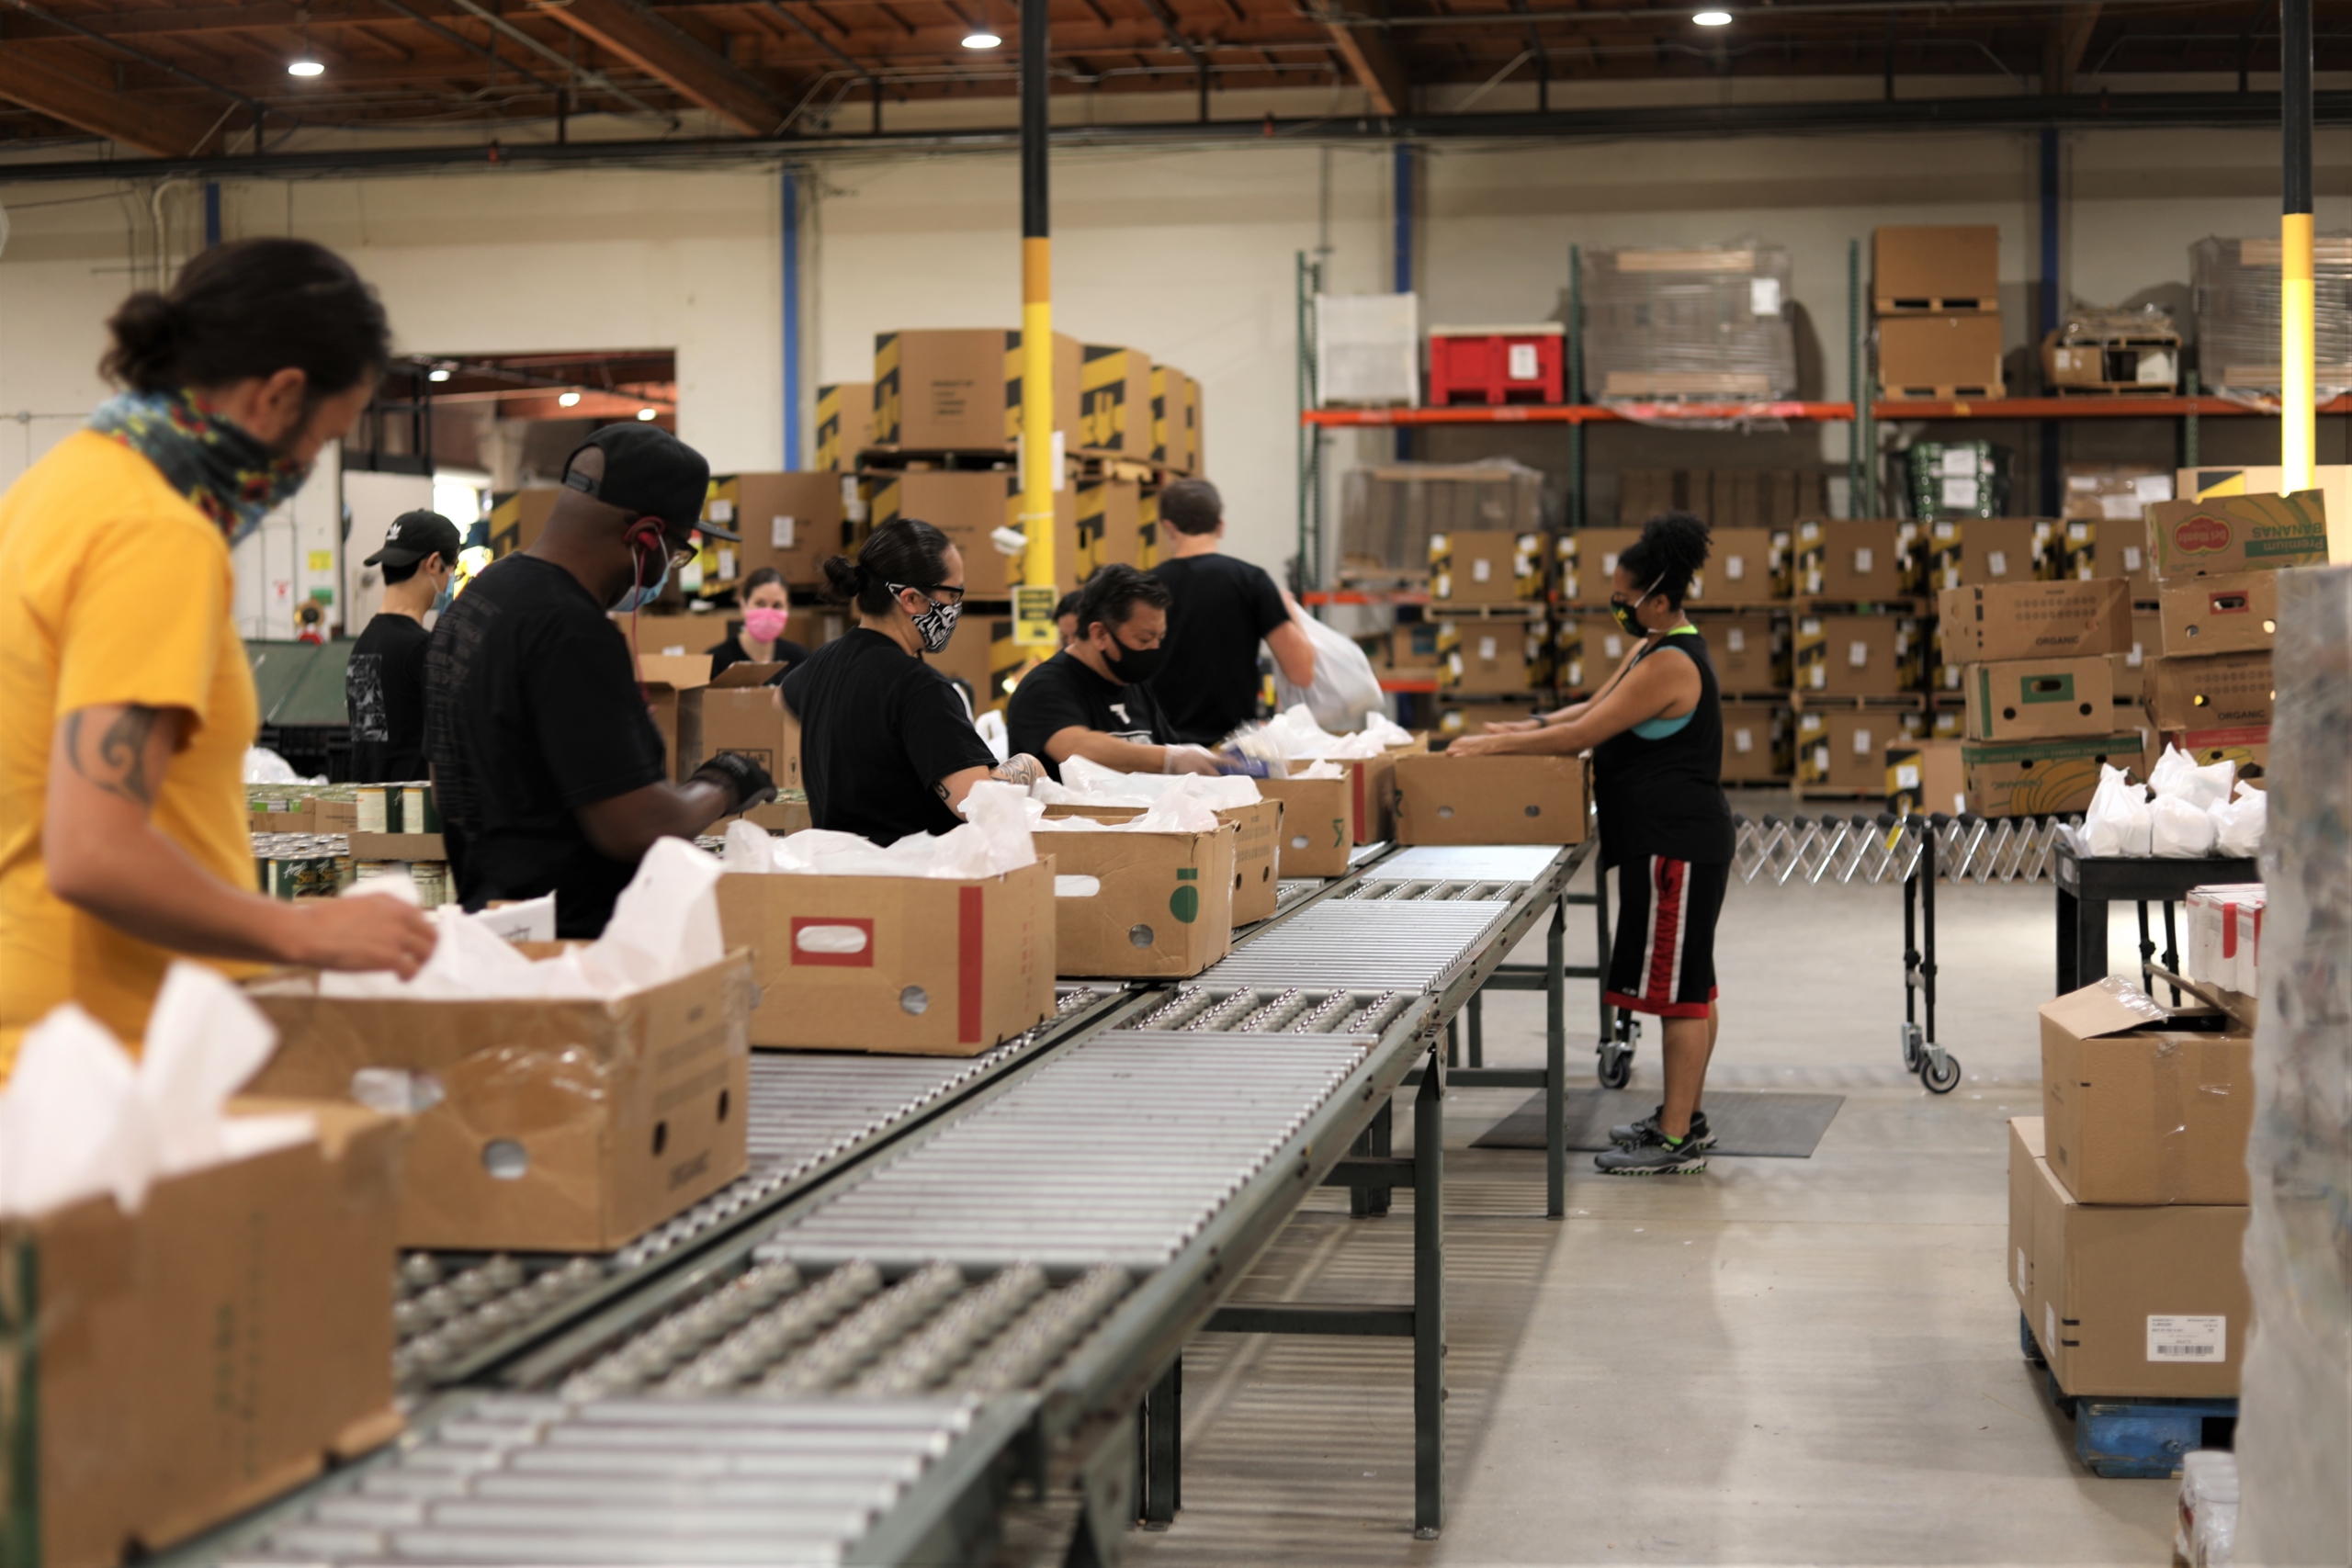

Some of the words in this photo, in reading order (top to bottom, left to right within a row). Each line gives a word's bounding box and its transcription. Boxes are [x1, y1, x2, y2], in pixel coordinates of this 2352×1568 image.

[2211, 530, 2227, 542] Del
[2252, 522, 2323, 538] BANANAS
[2177, 531, 2210, 543] Monte
[2263, 536, 2324, 551] Premium
[2035, 635, 2080, 646] ORGANIC
[2217, 709, 2266, 721] ORGANIC
